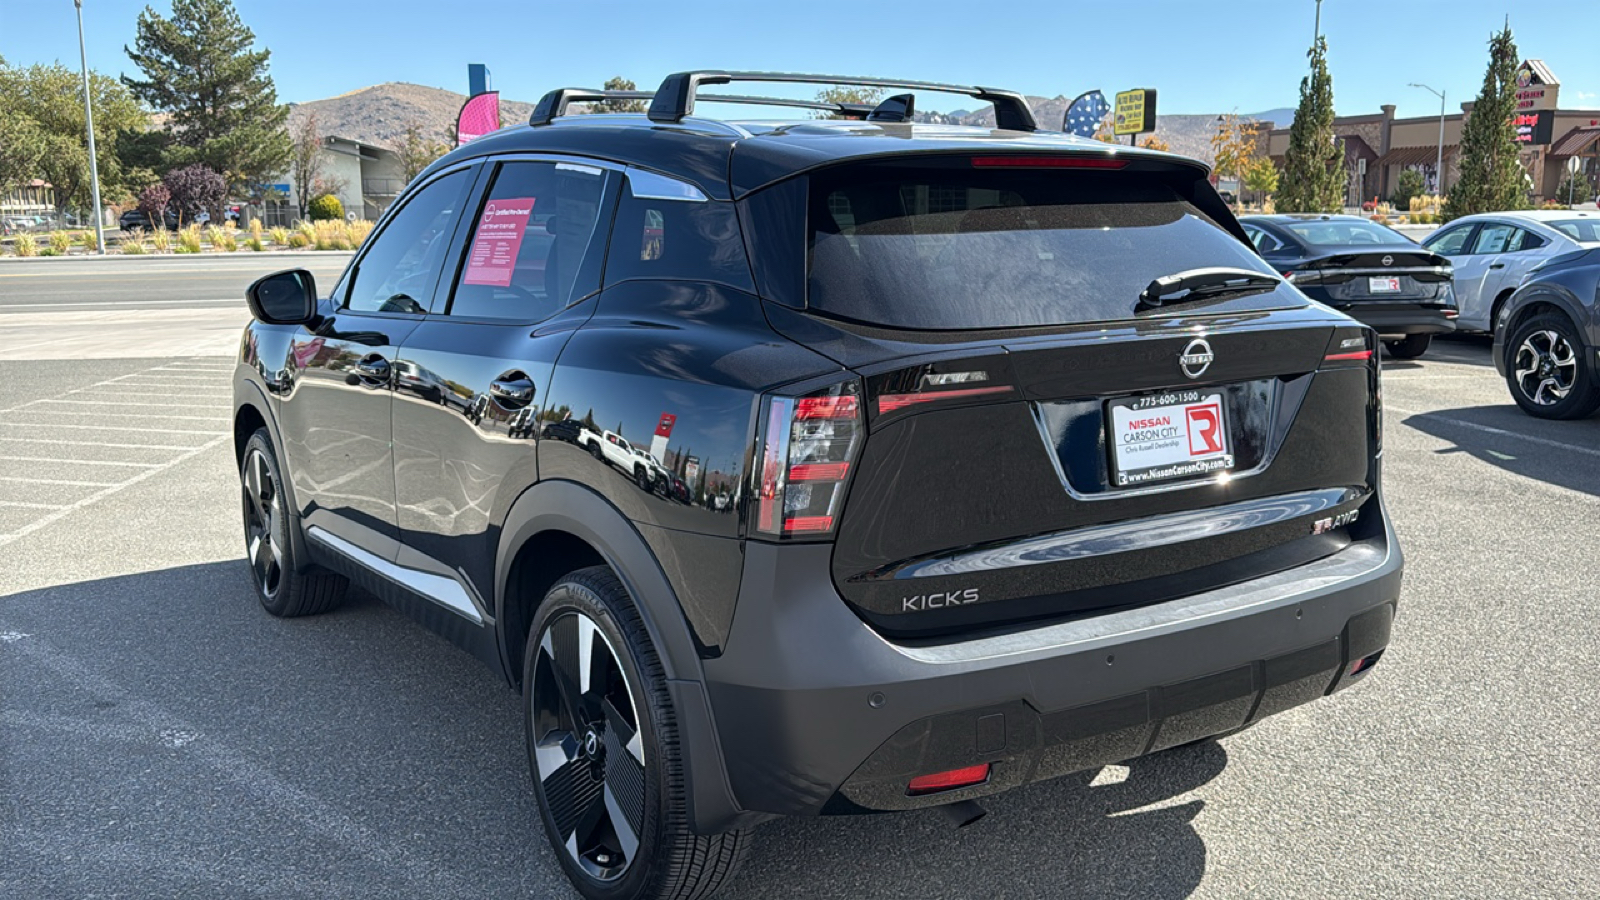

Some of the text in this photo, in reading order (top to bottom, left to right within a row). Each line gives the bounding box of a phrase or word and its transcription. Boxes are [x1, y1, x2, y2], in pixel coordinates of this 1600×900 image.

[1179, 354, 1214, 365] NISSAN
[1140, 392, 1198, 406] 775-600-1500
[1129, 416, 1170, 430] NISSAN
[1123, 426, 1178, 443] CARSON CITY
[1129, 459, 1225, 482] www.NissanCarsonCity.com
[1332, 509, 1359, 530] AWD
[902, 588, 979, 611] KICKS
